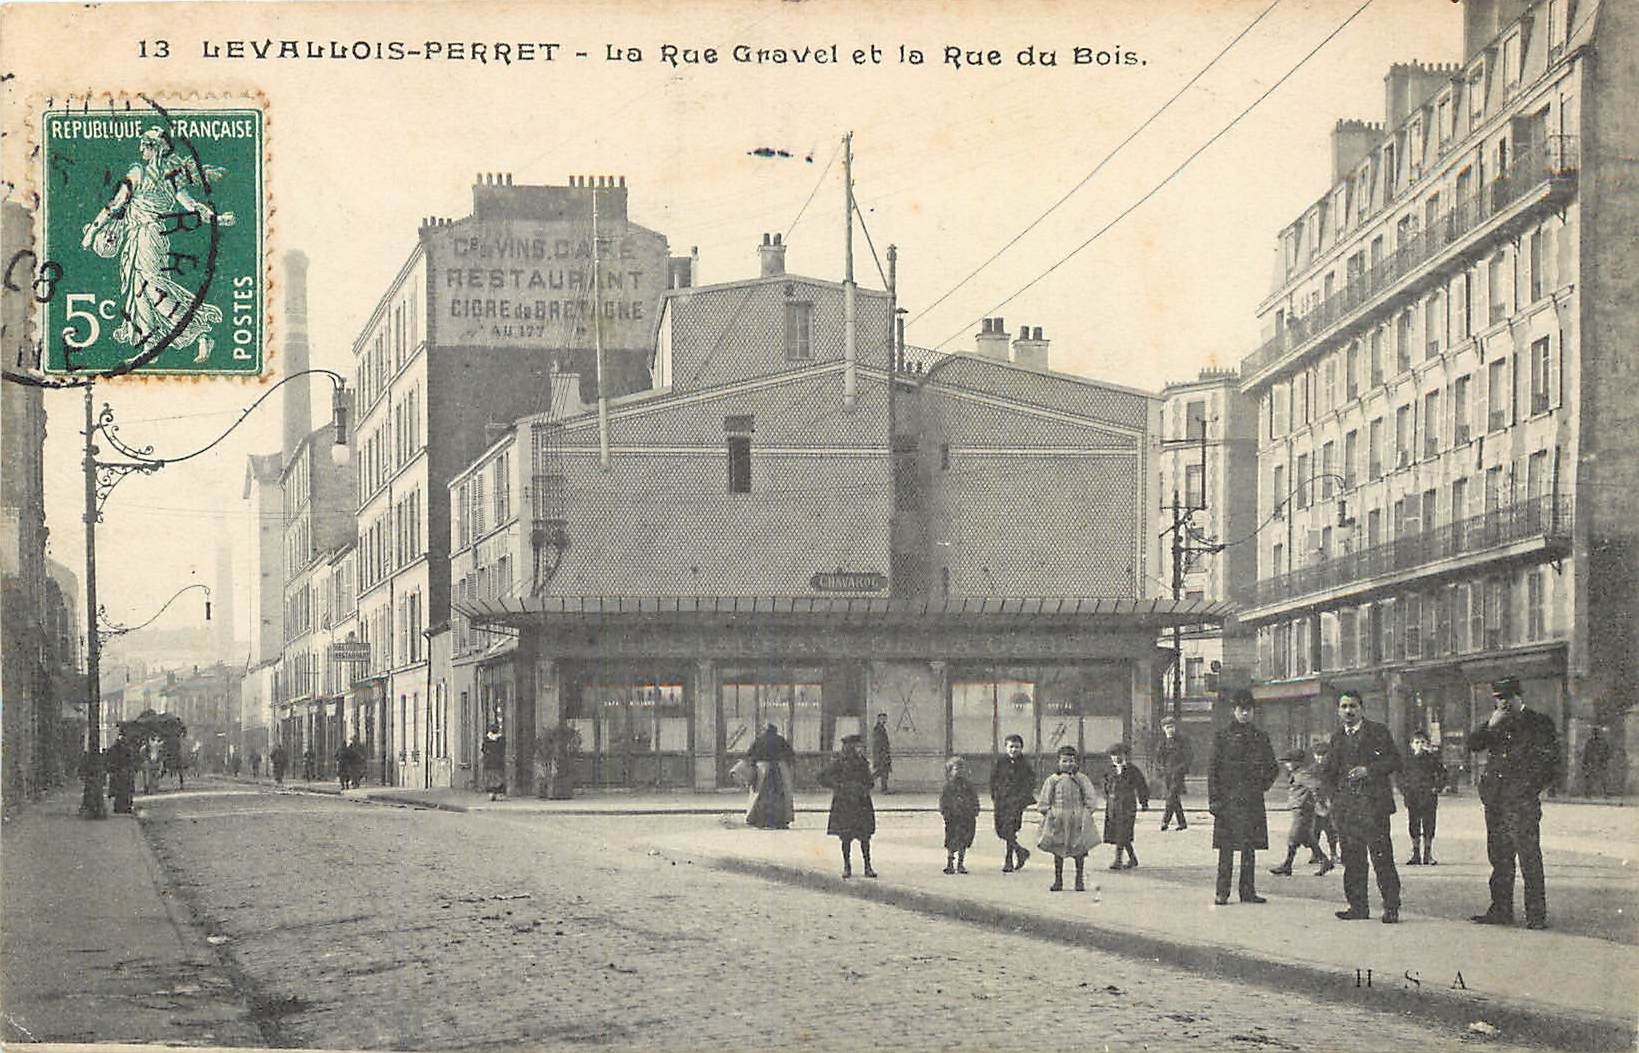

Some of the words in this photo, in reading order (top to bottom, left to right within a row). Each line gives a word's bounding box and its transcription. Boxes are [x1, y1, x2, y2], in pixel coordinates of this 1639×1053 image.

[169, 119, 252, 141] FRANÇAISE
[447, 269, 643, 289] RESTAURANT
[232, 275, 253, 360] POSTES
